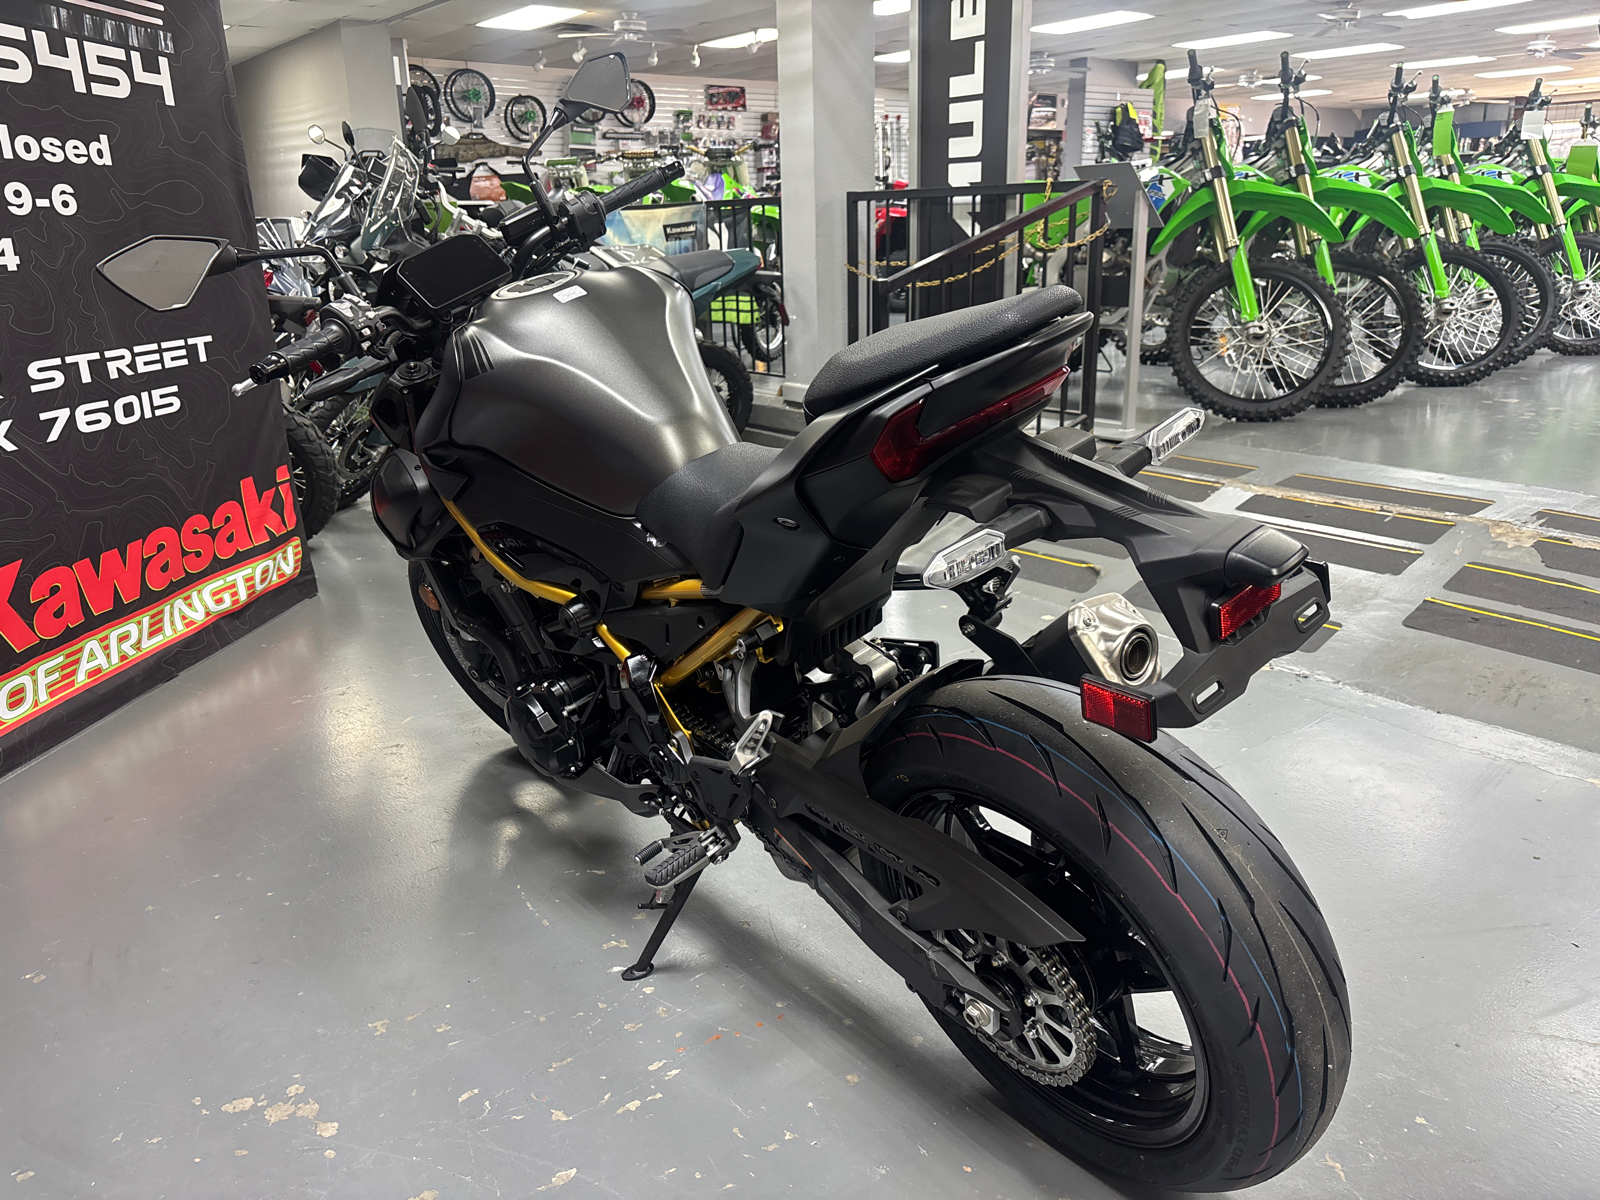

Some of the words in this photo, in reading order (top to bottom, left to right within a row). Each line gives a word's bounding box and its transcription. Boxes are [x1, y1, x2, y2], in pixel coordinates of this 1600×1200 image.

[4, 181, 78, 217] 9-6
[27, 334, 214, 394] STREET
[38, 384, 182, 443] 76015
[0, 654, 65, 721] OF
[76, 544, 296, 684] ARLINGTON
